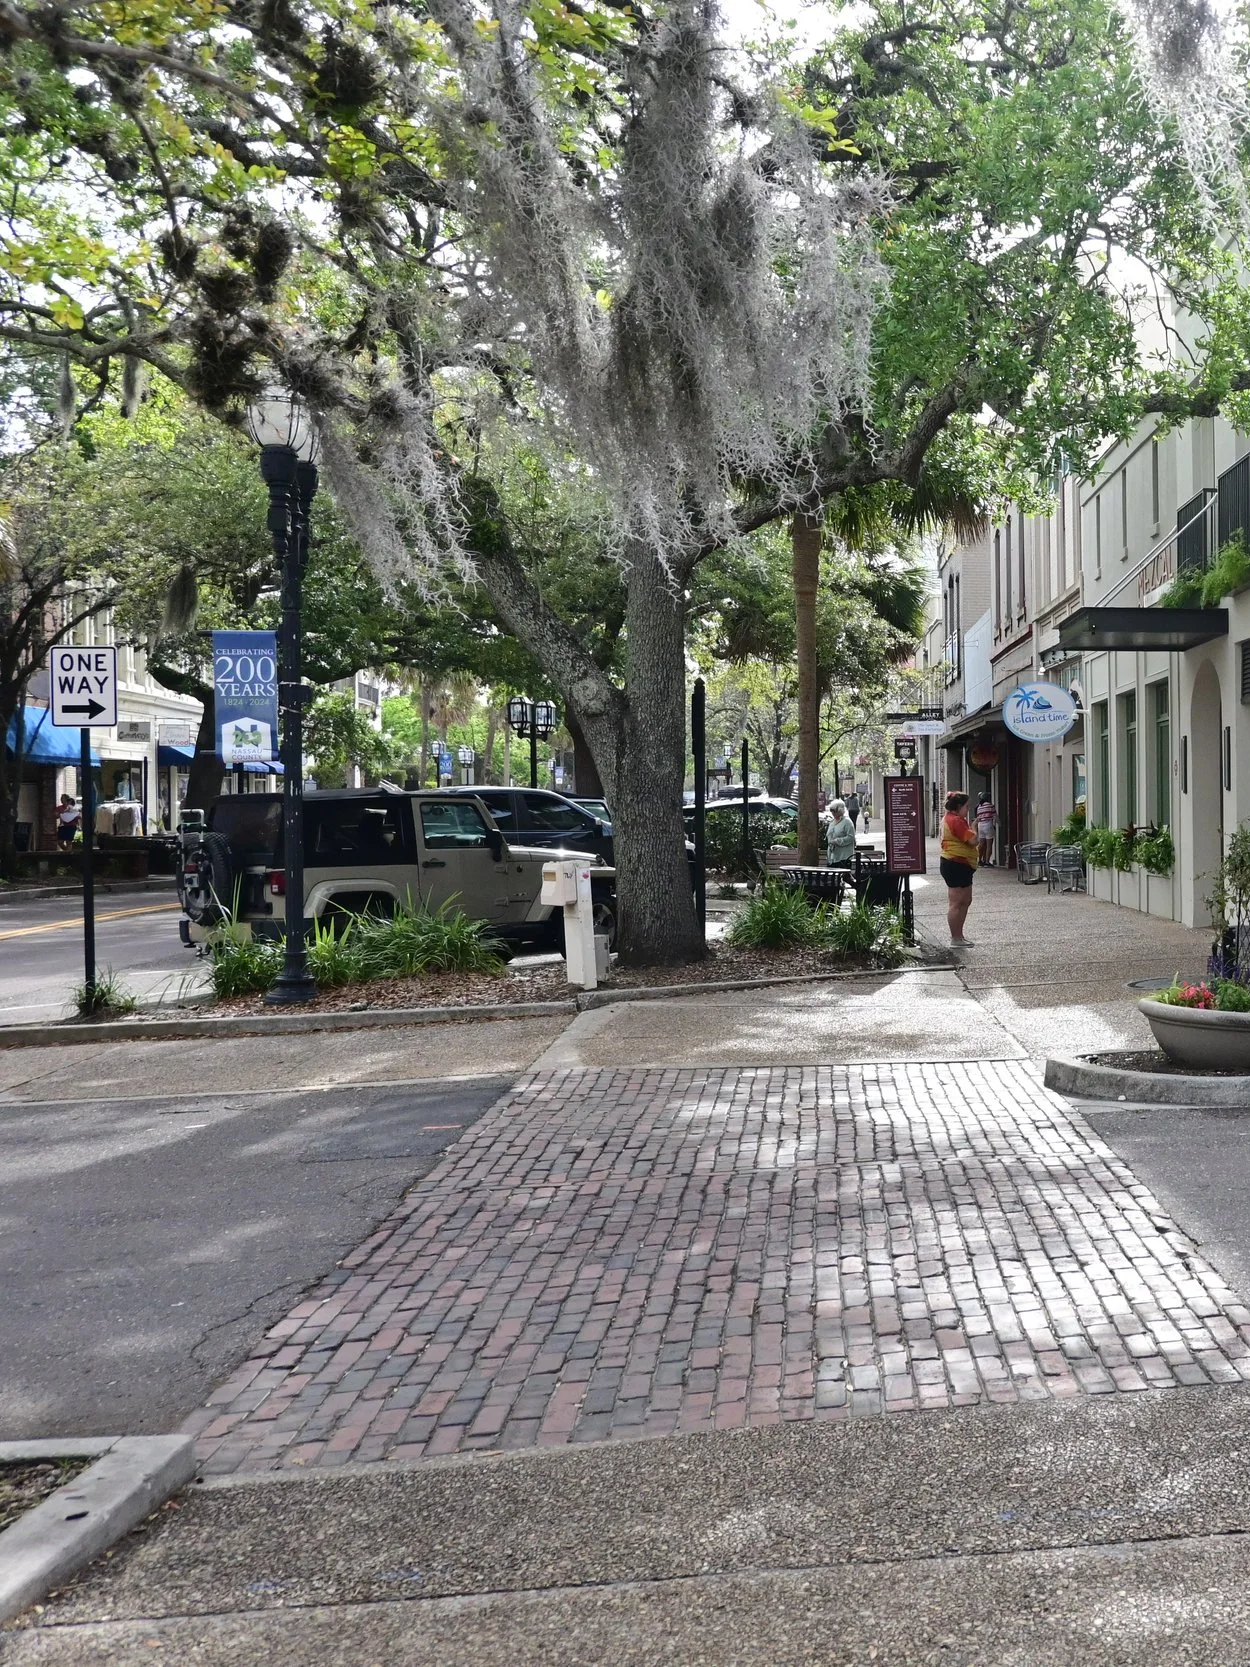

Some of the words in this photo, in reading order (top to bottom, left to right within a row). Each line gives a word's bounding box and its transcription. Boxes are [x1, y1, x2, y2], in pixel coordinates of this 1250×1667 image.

[215, 648, 274, 656] CELEBRATING
[60, 653, 107, 672] ONE
[215, 655, 275, 683] 200
[58, 676, 109, 694] WAY
[215, 683, 275, 697] YEARS
[224, 698, 243, 706] 1824
[249, 698, 270, 706] 2024
[1013, 713, 1046, 724] island
[1048, 712, 1070, 722] time
